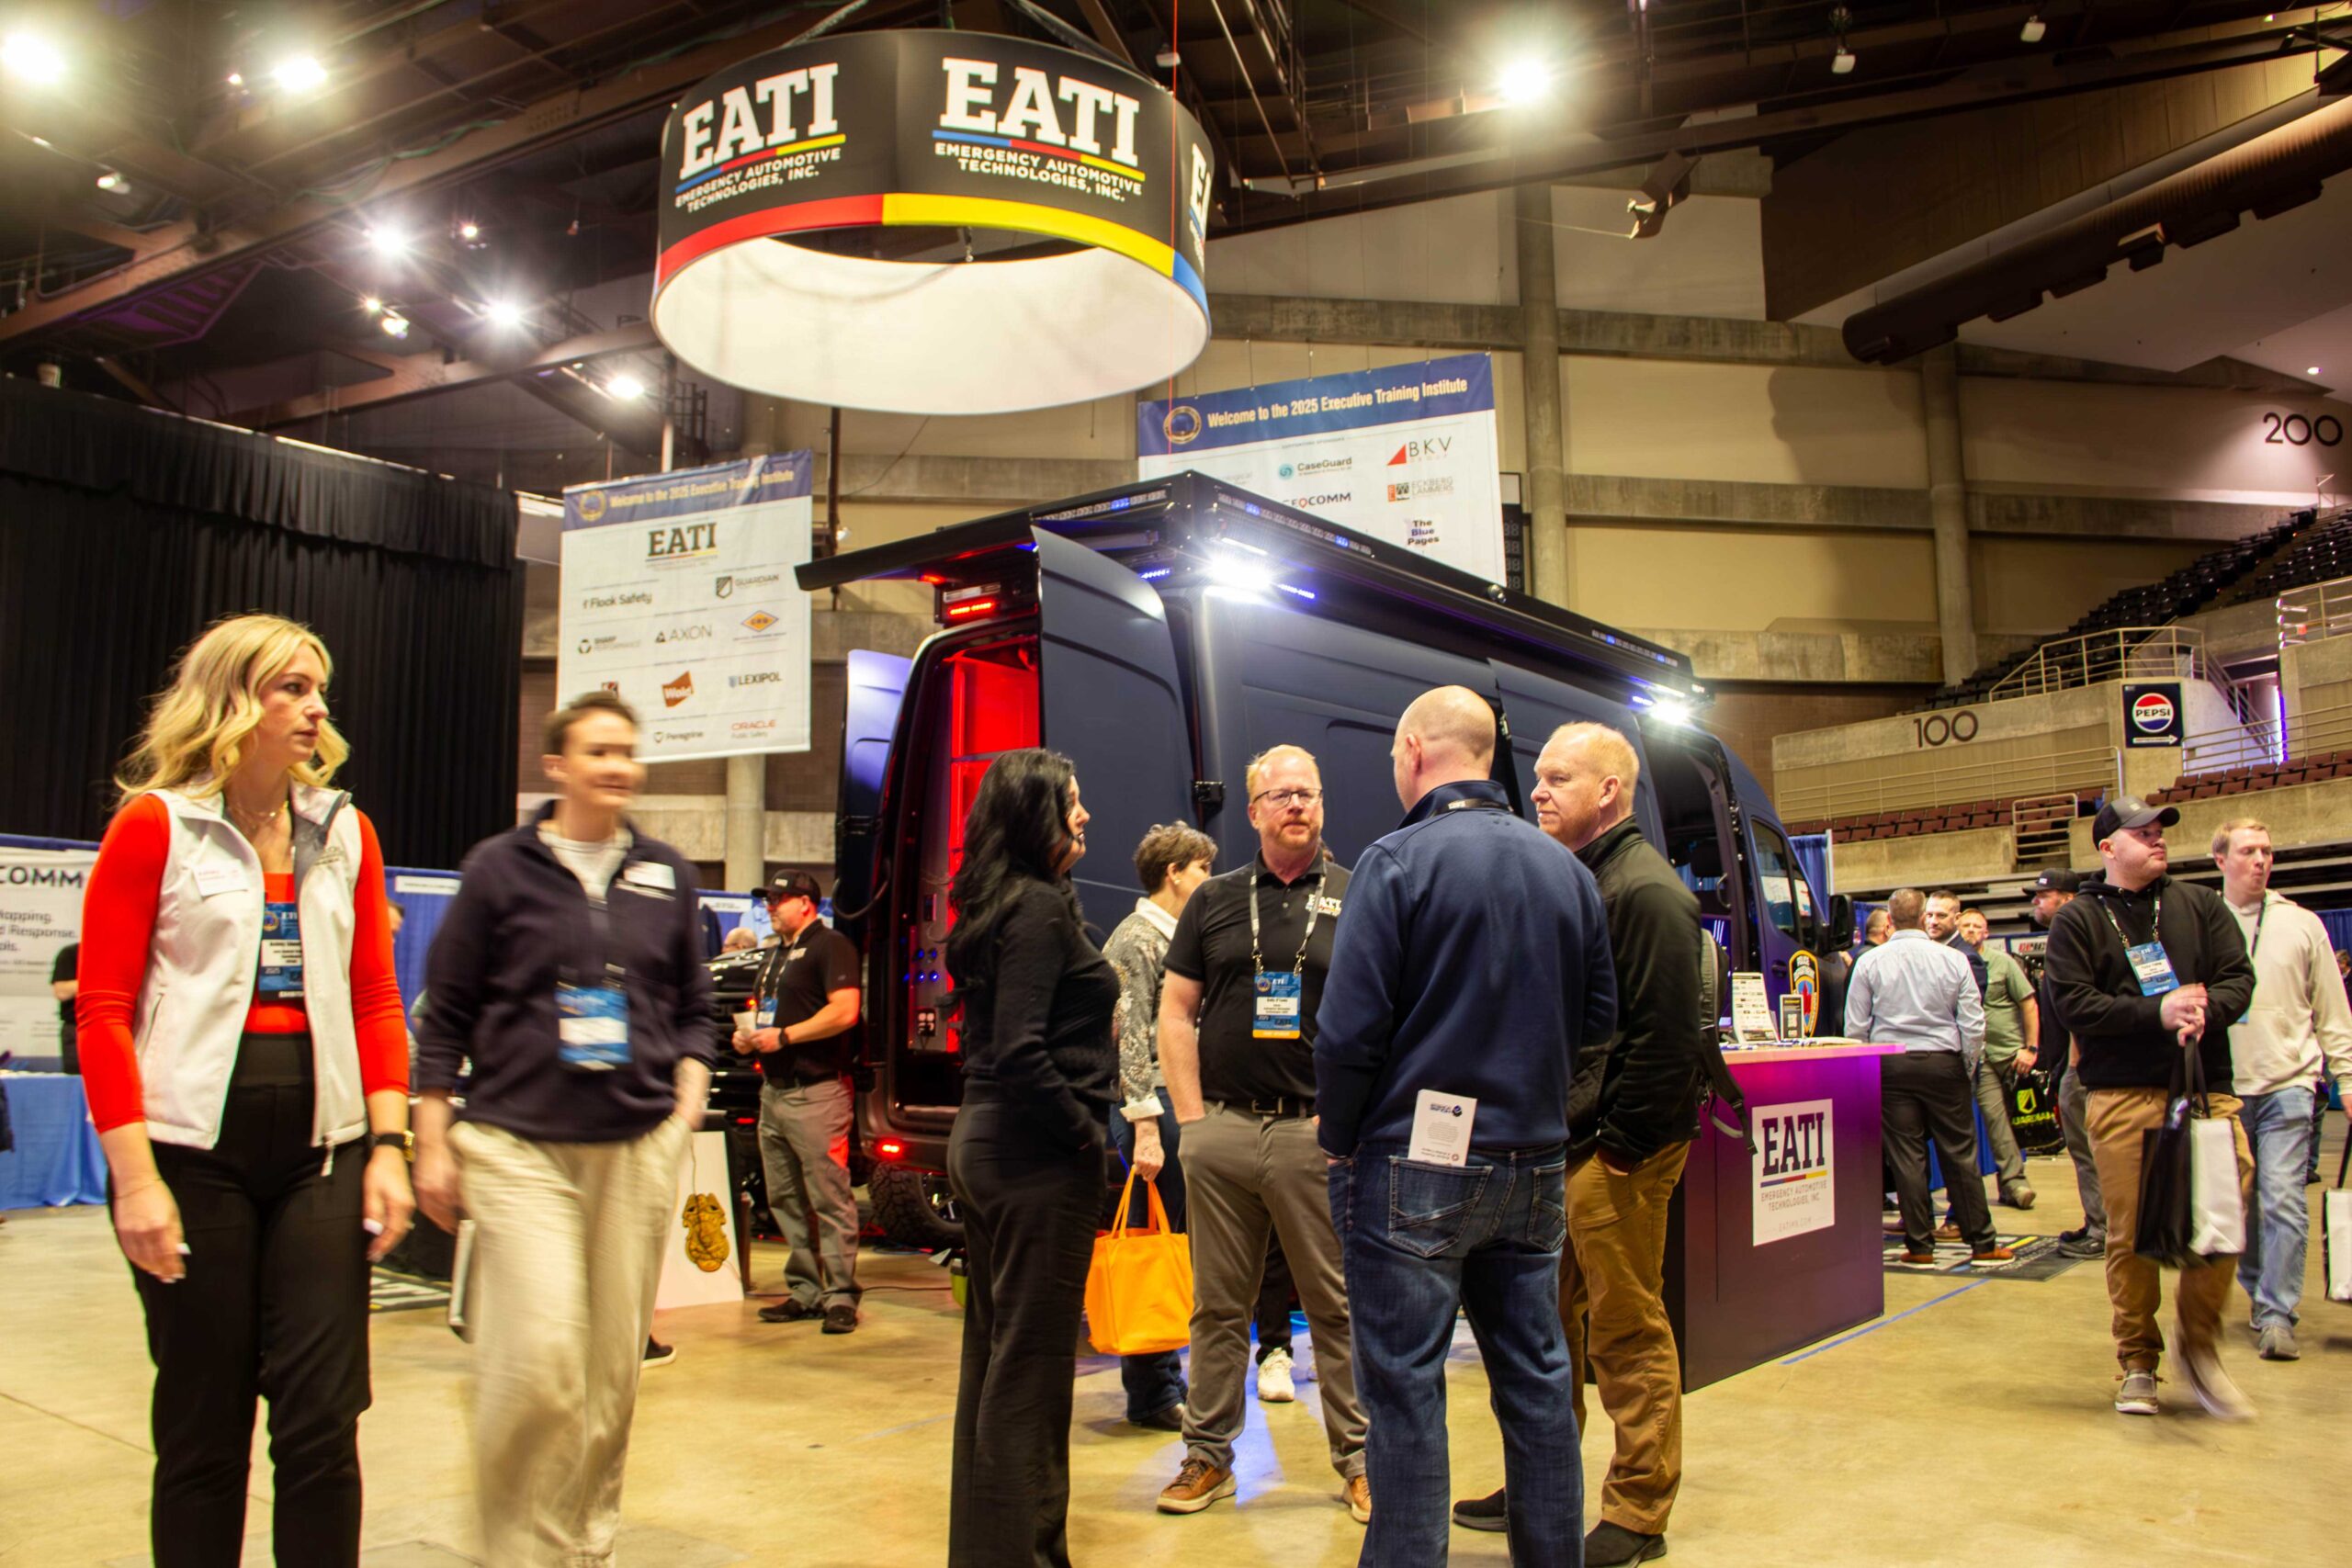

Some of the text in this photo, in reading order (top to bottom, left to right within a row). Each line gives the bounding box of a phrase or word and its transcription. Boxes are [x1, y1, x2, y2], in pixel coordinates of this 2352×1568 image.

[680, 62, 839, 180] EATI
[940, 57, 1139, 167] EATI
[675, 147, 841, 208] EMERGENCY AUTOMOTIVE
[934, 142, 1142, 196] EMERGENCY AUTOMOTIVE
[958, 158, 1125, 202] TECHNOLOGIES, INC.
[687, 164, 820, 213] TECHNOLOGIES, INC.
[1207, 378, 1467, 428] Welcome to the 2025 Executive Training Institute
[2263, 412, 2343, 446] 200
[1297, 457, 1352, 471] CaseGuard
[648, 522, 718, 557] EATI
[1411, 528, 1435, 536] Blue
[1412, 519, 1432, 527] The
[1408, 536, 1440, 546] Pages
[590, 595, 616, 609] Flock
[619, 592, 652, 604] Safety
[670, 625, 713, 641] AXON
[738, 671, 783, 686] LEXIPOL
[731, 719, 776, 731] ORACLE
[2135, 708, 2171, 716] PEPSI
[1913, 710, 1979, 749] 100
[1761, 1111, 1825, 1177] EATI
[1760, 1179, 1827, 1202] EMERGENCY AUTOMOTIVE
